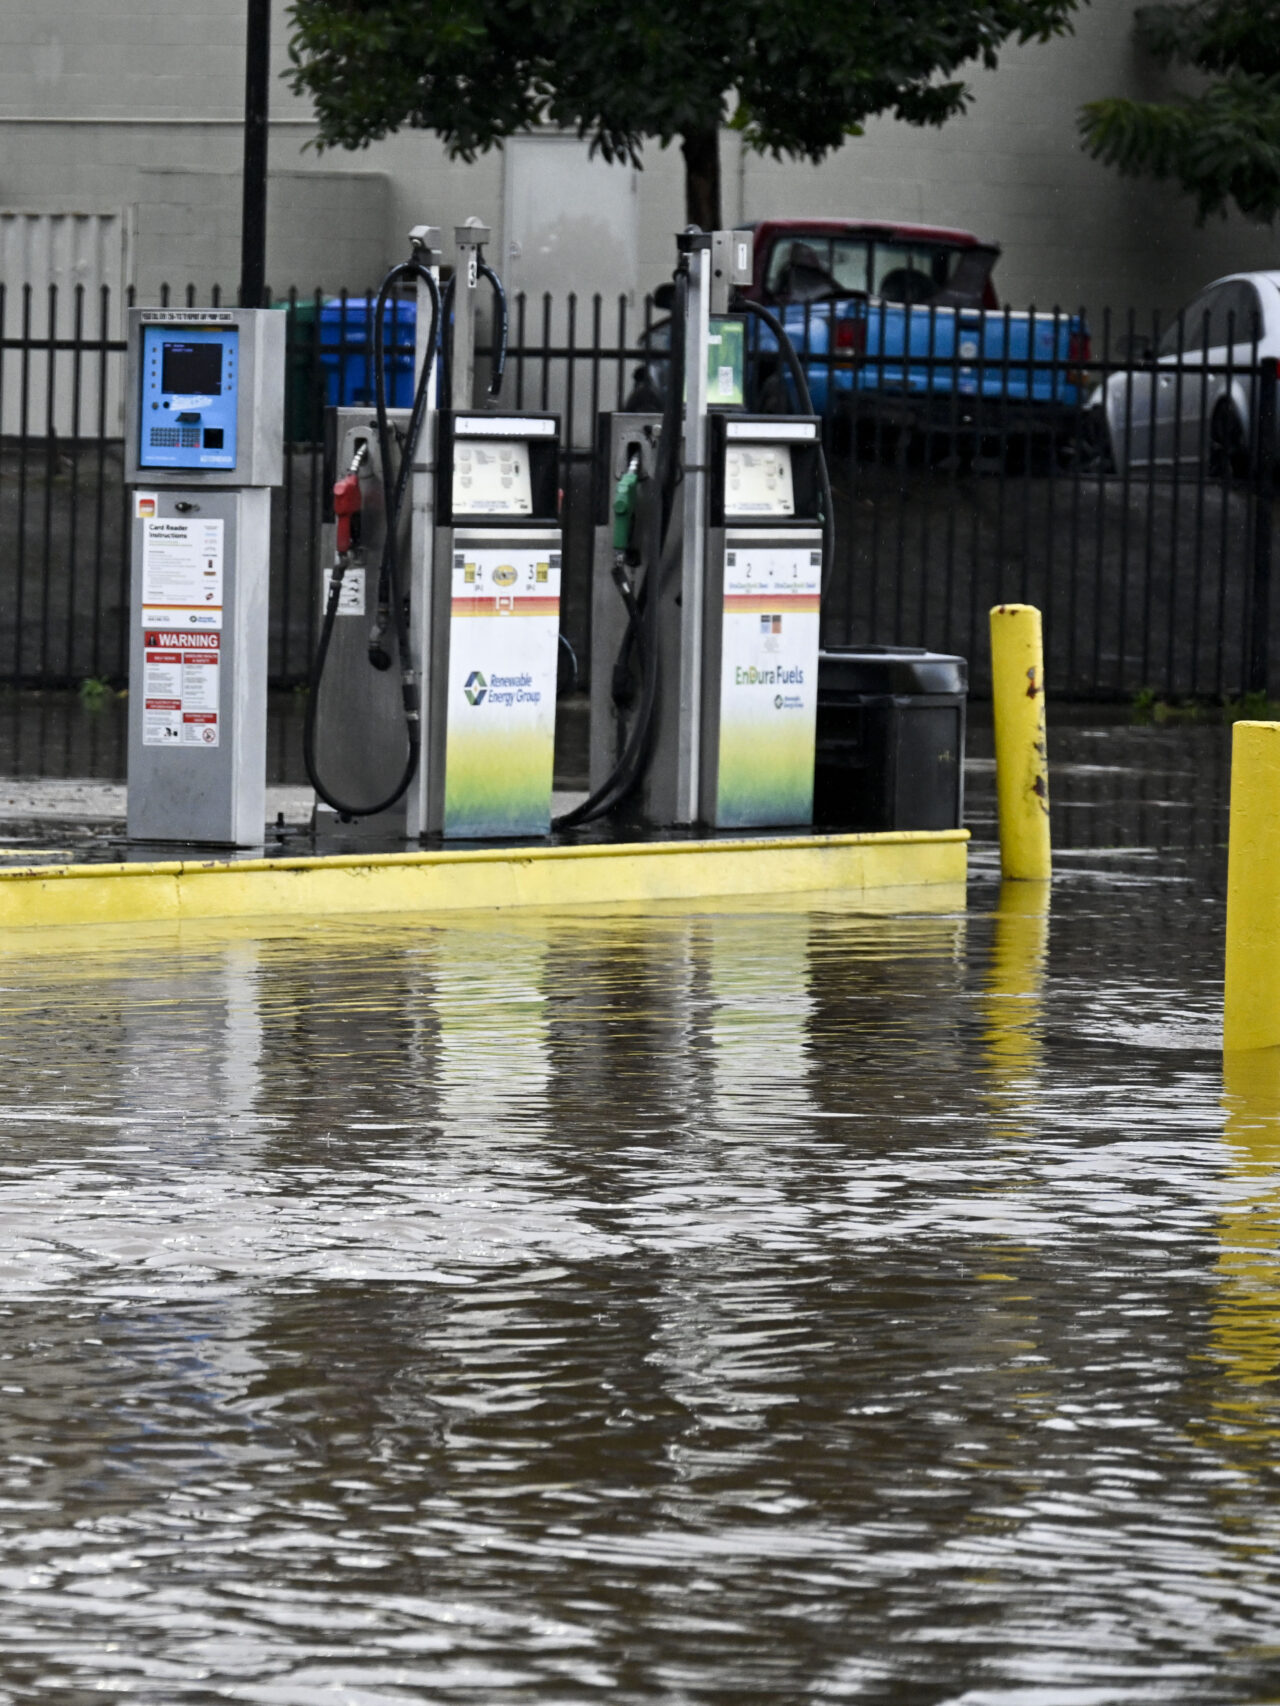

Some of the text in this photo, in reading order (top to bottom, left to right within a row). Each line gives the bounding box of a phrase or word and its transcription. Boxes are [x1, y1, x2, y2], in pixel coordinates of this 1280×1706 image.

[159, 633, 218, 648] WARNING
[490, 672, 532, 687] Renewable
[735, 665, 804, 685] EnDura Fuels
[488, 688, 541, 707] Energy Group
